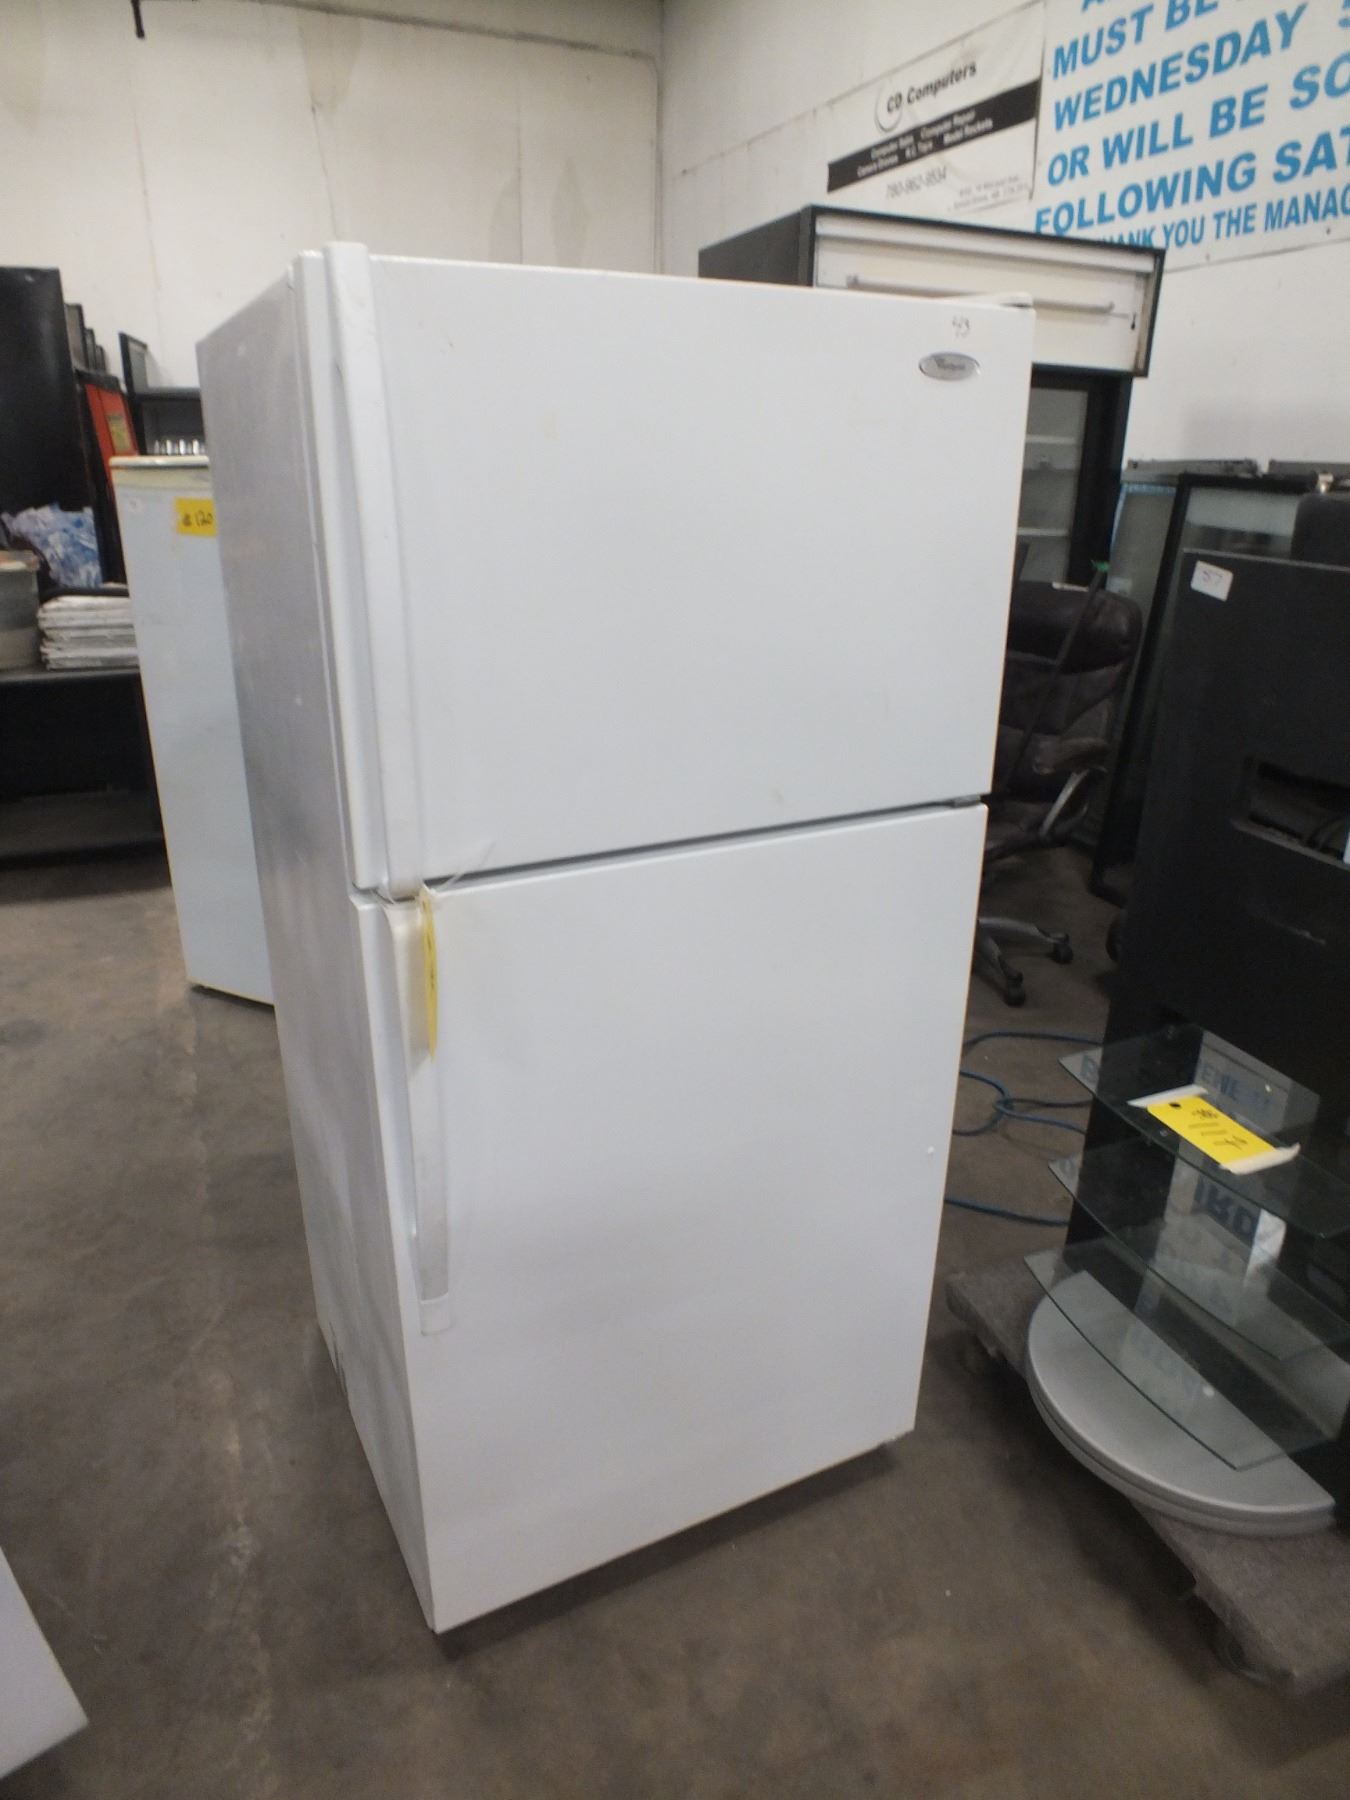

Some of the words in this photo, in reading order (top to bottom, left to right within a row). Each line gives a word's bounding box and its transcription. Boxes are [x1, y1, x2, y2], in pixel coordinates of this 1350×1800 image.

[906, 61, 977, 104] Computers
[1052, 5, 1154, 80] MUST
[1053, 3, 1309, 132] WEDNESDAY
[1047, 145, 1090, 187] OR
[1101, 112, 1194, 170] WILL
[1208, 84, 1269, 139] BE
[1288, 52, 1350, 110] SO
[1035, 151, 1257, 236] FOLLOWING
[1163, 215, 1205, 251] YOU
[1213, 203, 1258, 240] THE
